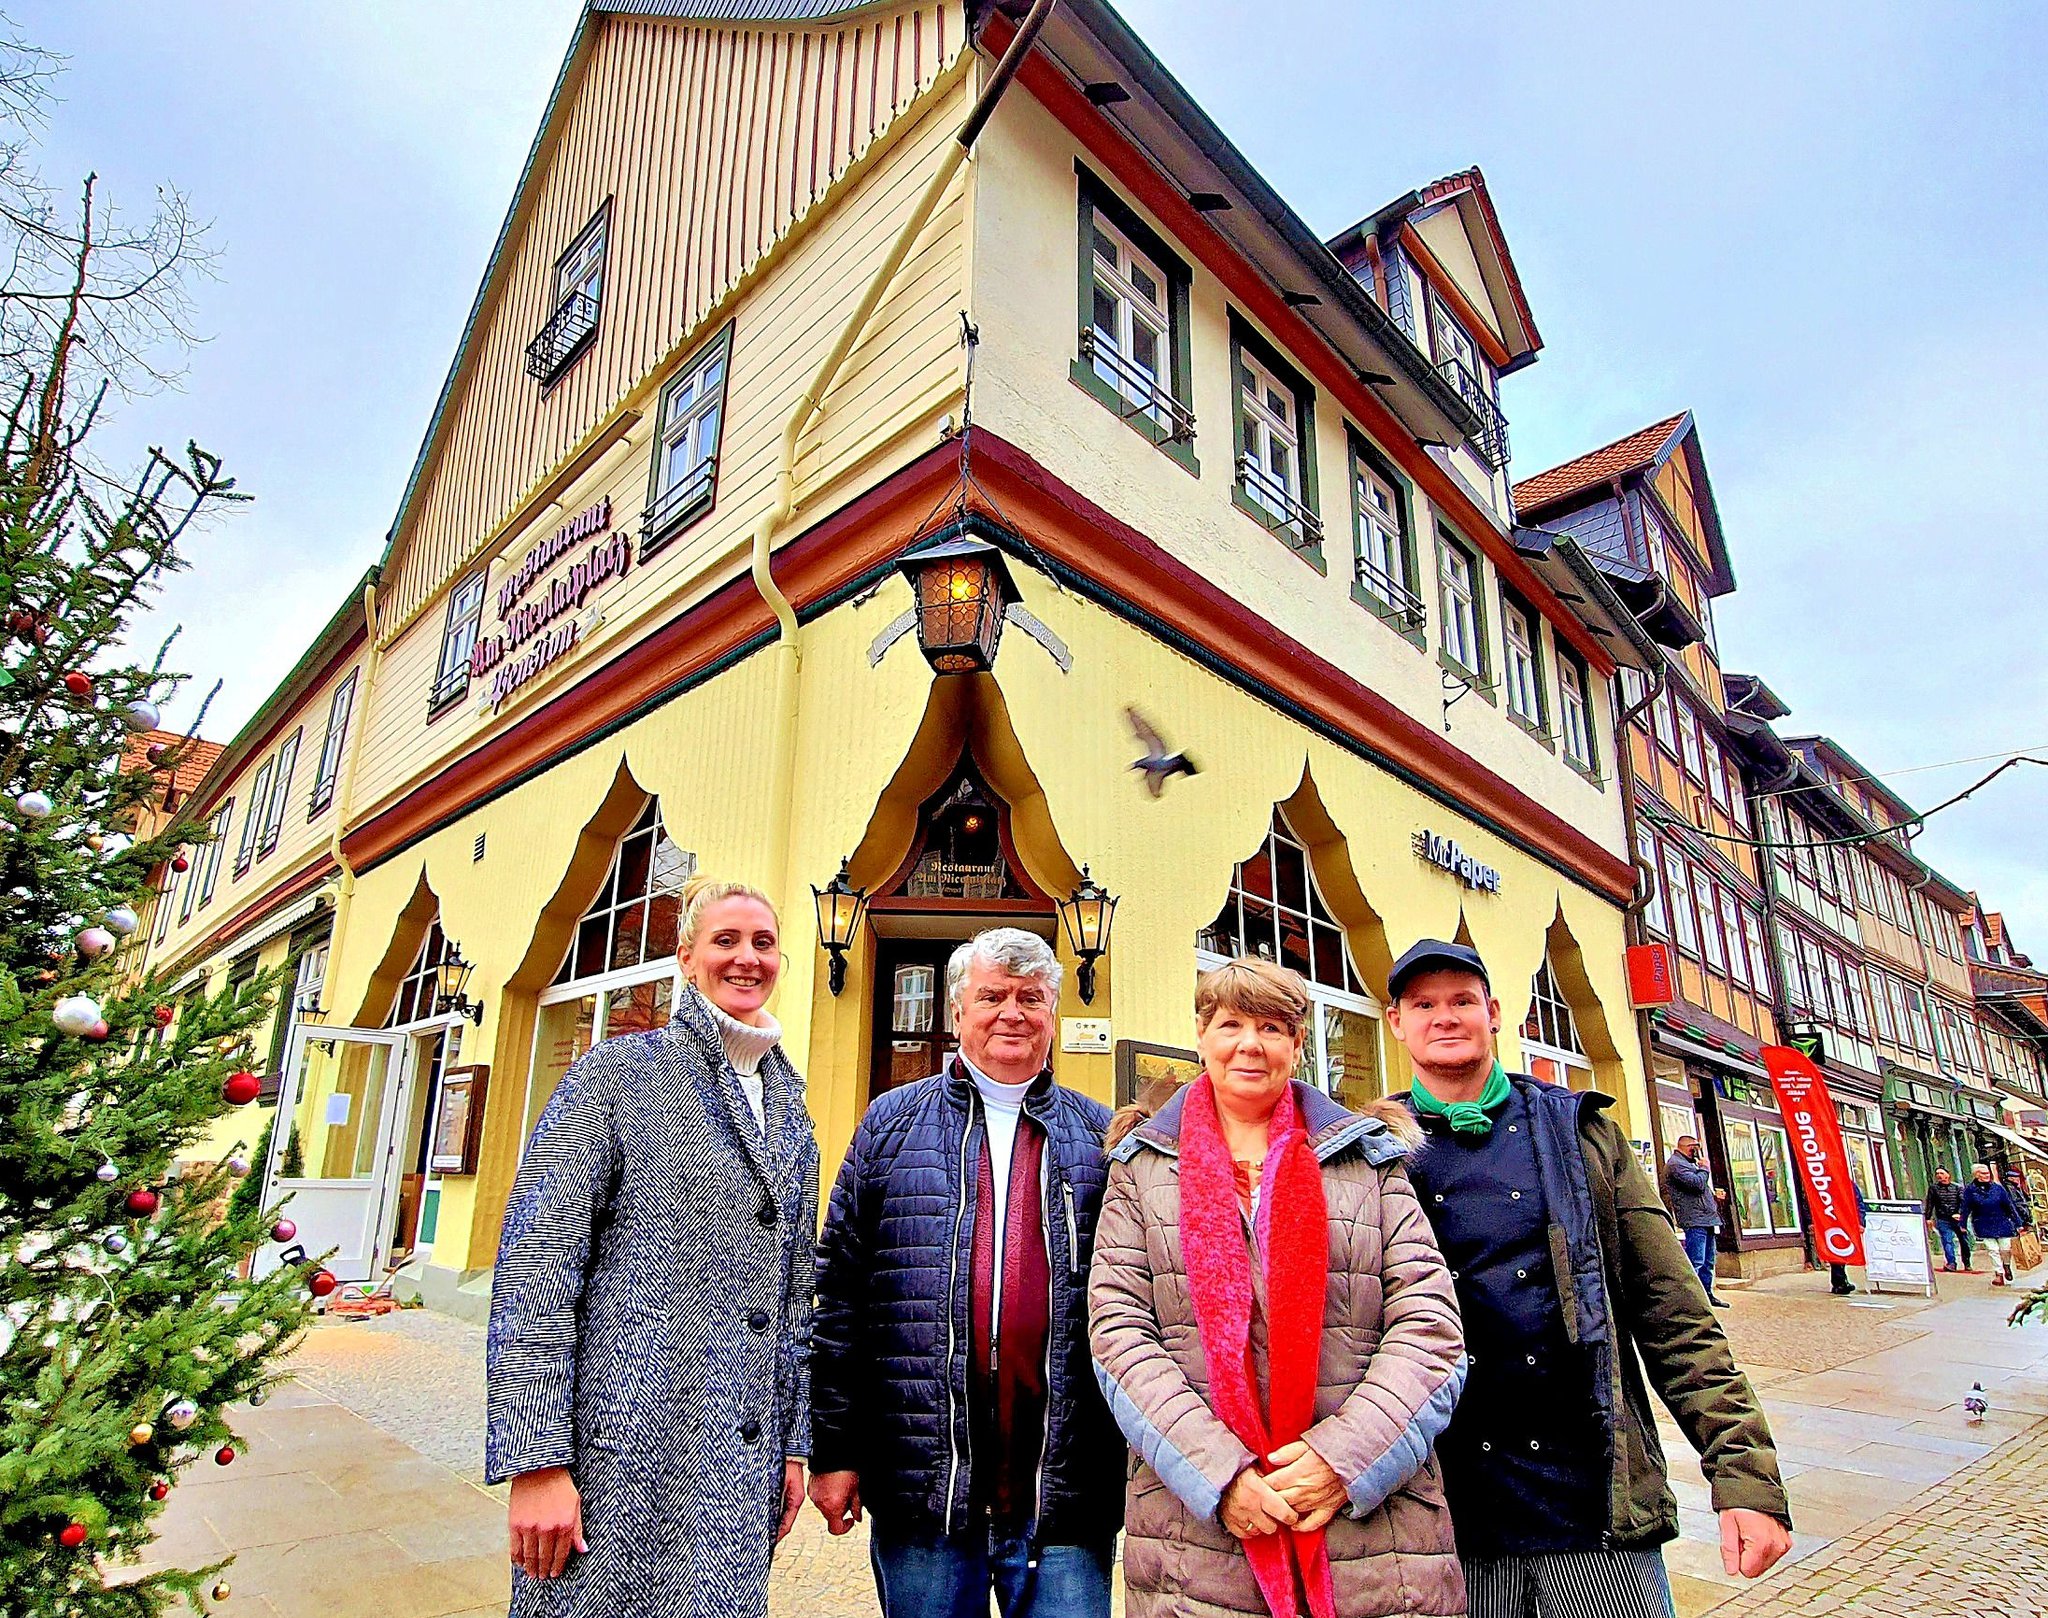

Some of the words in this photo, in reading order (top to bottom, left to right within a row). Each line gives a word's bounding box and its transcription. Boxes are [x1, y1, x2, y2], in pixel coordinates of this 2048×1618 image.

[498, 494, 614, 621] Restaurant
[470, 635, 505, 678] Am
[491, 619, 580, 715] Pension
[931, 860, 995, 873] Restaurant
[1422, 829, 1501, 892] McPaper
[1880, 1204, 1913, 1212] freenet
